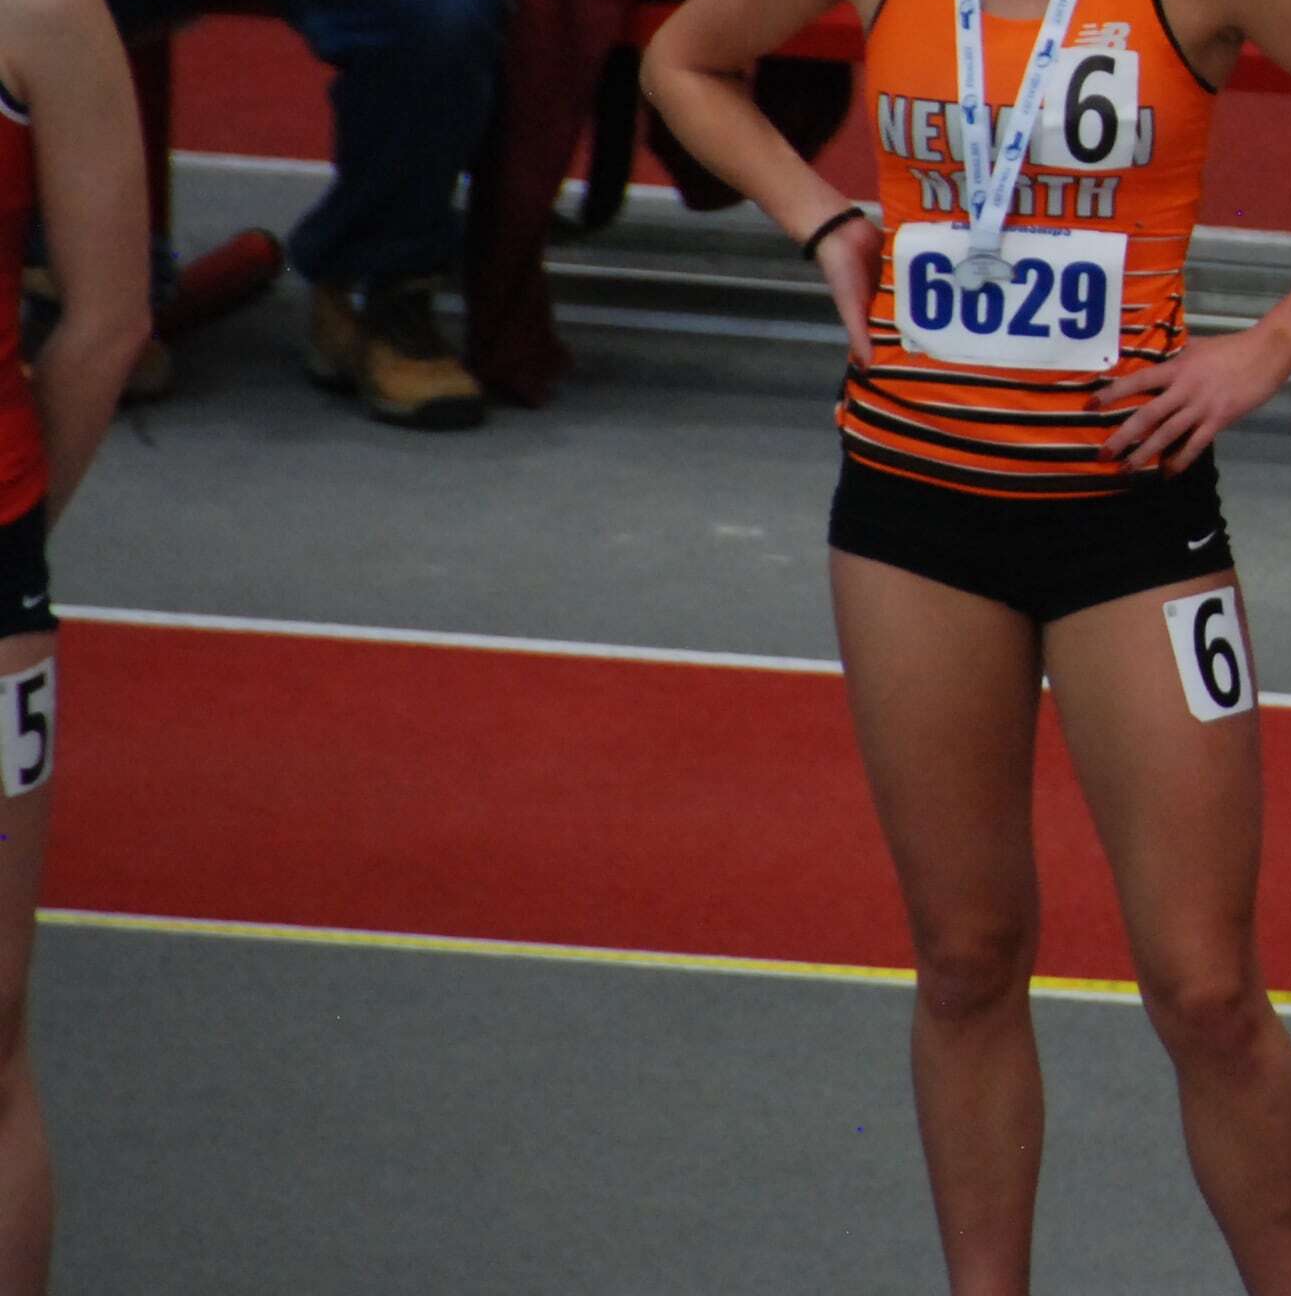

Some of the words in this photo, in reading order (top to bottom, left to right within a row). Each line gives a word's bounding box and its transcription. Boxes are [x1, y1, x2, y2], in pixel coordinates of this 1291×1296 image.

[1065, 54, 1119, 164] 6
[908, 251, 1107, 340] 6629
[1193, 597, 1241, 708] 6
[16, 674, 47, 786] 5
